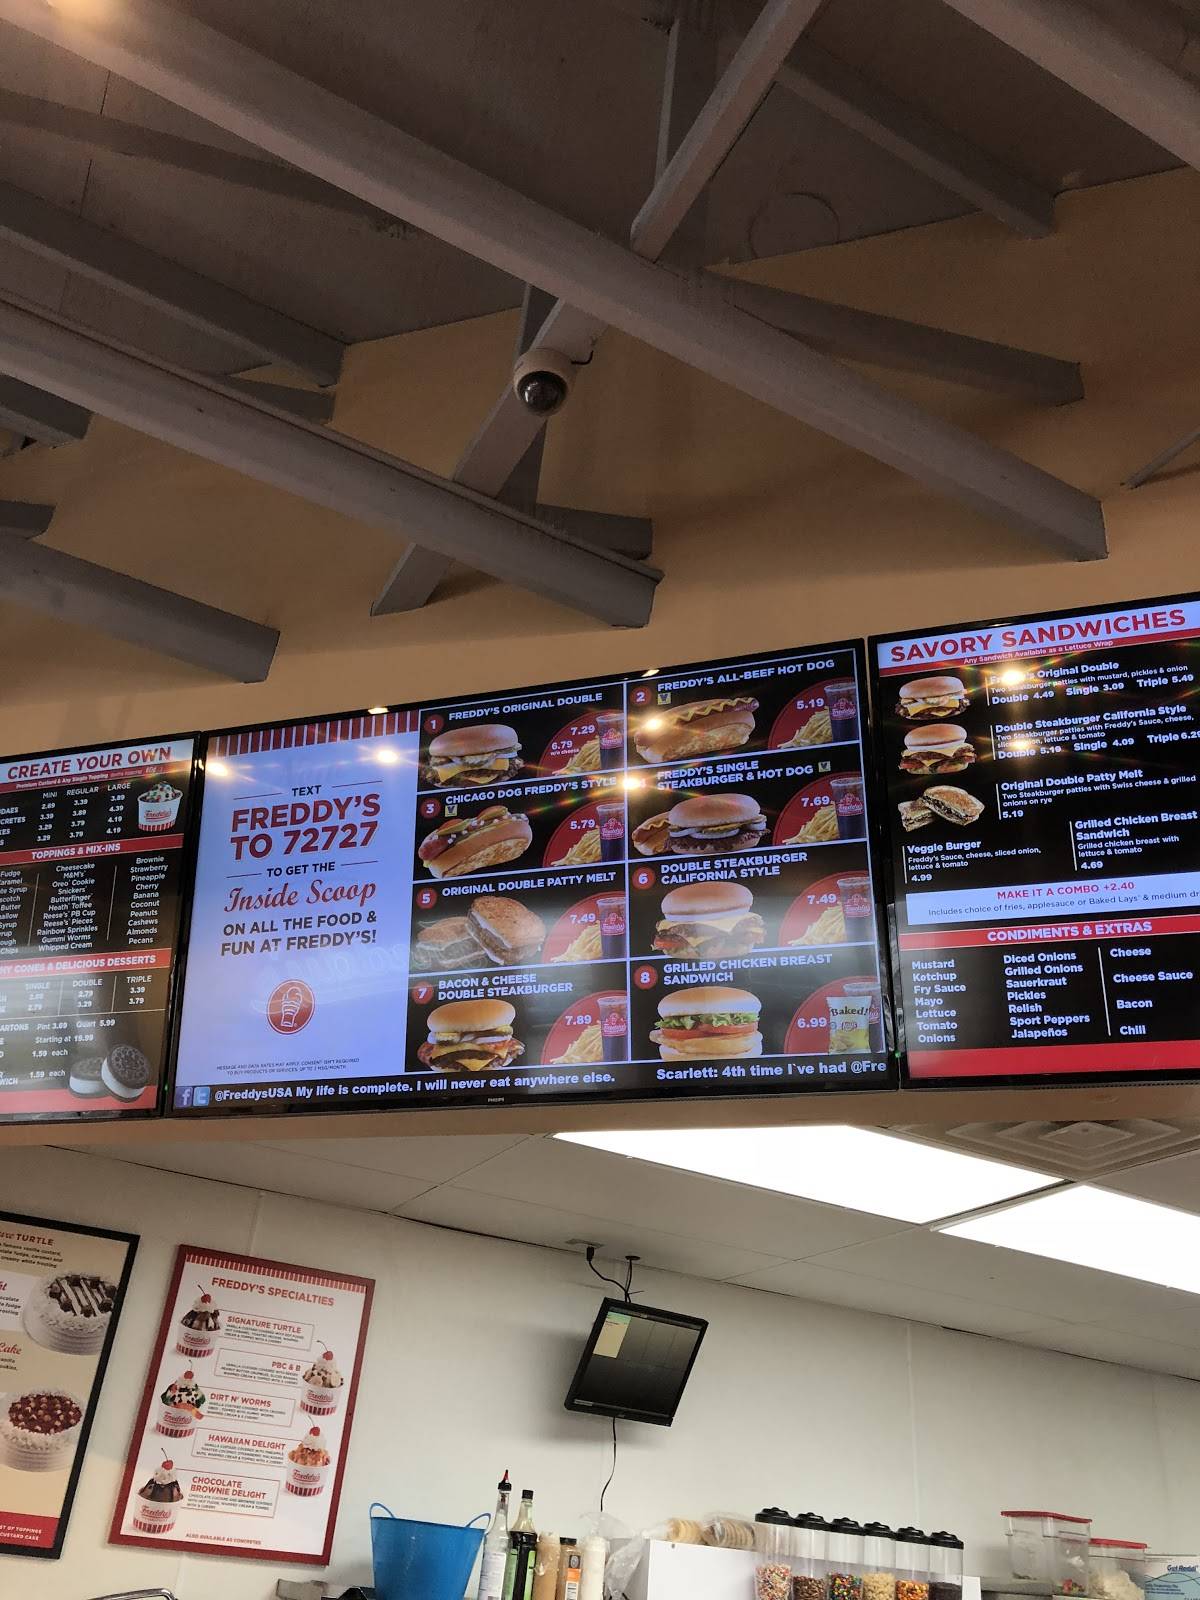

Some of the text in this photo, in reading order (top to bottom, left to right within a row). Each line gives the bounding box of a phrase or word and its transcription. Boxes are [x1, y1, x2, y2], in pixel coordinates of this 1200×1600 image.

[891, 609, 1186, 662] SAVORY SANDWICHES
[980, 654, 1013, 662] Sandwich
[1015, 649, 1047, 657] Available
[1065, 643, 1091, 651] Lettuce
[1093, 640, 1113, 648] Wrap
[657, 660, 835, 692] FREDDY'S ALL-BEEF HOT DOG
[636, 692, 645, 701] 2
[796, 698, 824, 709] 5.19
[449, 693, 602, 720] FREDDY'S ORIGINAL DOUBLE
[430, 720, 436, 729] 1
[995, 704, 1186, 733] Double Steakburger California Style
[571, 725, 595, 735] 7.29
[552, 741, 572, 749] 6.79
[8, 747, 171, 779] CREATE YOUR OWN
[658, 761, 759, 780] FREDDY'S SINGLE
[657, 766, 813, 790] STEAKBURGER & HOT DOG
[1001, 769, 1143, 791] Original Double Patty Melt
[292, 785, 322, 796] TEXT
[446, 777, 616, 804] CHICAGO DOG FREDDY'S STYLE
[426, 804, 434, 813] 3
[801, 796, 830, 807] 7.69
[232, 794, 380, 832] FREDDY'S
[1003, 810, 1023, 818] 5.19
[1075, 811, 1197, 829] Grilled Chicken Breast
[570, 820, 595, 829] 5.79
[231, 821, 378, 860] TO 72727
[1076, 828, 1130, 840] Sandwich
[32, 847, 77, 859] TOPPINGS
[86, 844, 120, 853] MIX-INS
[907, 840, 981, 855] Veggie Burger
[56, 863, 95, 871] Cheesecake
[130, 865, 168, 873] Strawberry
[267, 862, 335, 877] TO GET THE
[661, 853, 808, 873] DOUBLE STEAKBURGER
[1081, 861, 1103, 869] 4.69
[131, 874, 165, 882] Pineapple
[639, 874, 648, 884] 6
[661, 866, 780, 884] CALIFORNIA STYLE
[442, 872, 616, 896] ORIGINAL DOUBLE PATTY MELT
[997, 890, 1029, 900] MAKE
[1046, 888, 1054, 896] A
[1058, 884, 1100, 894] COMBO
[1104, 882, 1134, 891] +2.40
[224, 879, 376, 912] Inside Scoop
[422, 894, 430, 903] 5
[807, 894, 837, 904] 7.49
[223, 910, 377, 936] ON ALL THE FOOD &
[570, 914, 595, 923] 7.49
[987, 922, 1152, 942] CONDIMENTS & EXTRAS
[221, 930, 376, 956] FUN AT FREDDY'S!
[664, 954, 832, 973] GRILLED CHICKEN BREAST
[439, 974, 536, 989] BACON & CHEESE
[640, 973, 649, 983] 8
[664, 972, 733, 985] SANDWICH
[1006, 977, 1067, 988] Sauerkraut
[418, 988, 427, 998] 7
[439, 983, 573, 1000] DOUBLE STEAKBURGER
[1116, 999, 1152, 1009] Bacon
[830, 1006, 869, 1017] Baked!
[916, 1008, 956, 1018] Lettuce
[565, 1015, 591, 1025] 7.89
[798, 1018, 827, 1029] 6.99
[1011, 1028, 1068, 1040] Jalapeños
[1120, 1026, 1146, 1036] Chili
[657, 1061, 886, 1080] Scarlett: 4th time I`ve had @Fre
[215, 1073, 615, 1102] @FreddysUSA My life is complete. I will never eat anywhere else.
[17, 1234, 54, 1246] TURTLE
[212, 1277, 334, 1306] FREDDY'S SPECIALTIES
[227, 1316, 302, 1333] SIGNATURE TURTLE
[272, 1361, 286, 1369] PBC
[210, 1393, 229, 1401] DIRT
[241, 1397, 272, 1407] WORMS
[208, 1434, 286, 1450] HAWAIIAN DELIGHT
[192, 1476, 242, 1488] CHOCOLATE
[190, 1485, 266, 1499] BROWNIE DELIGHT
